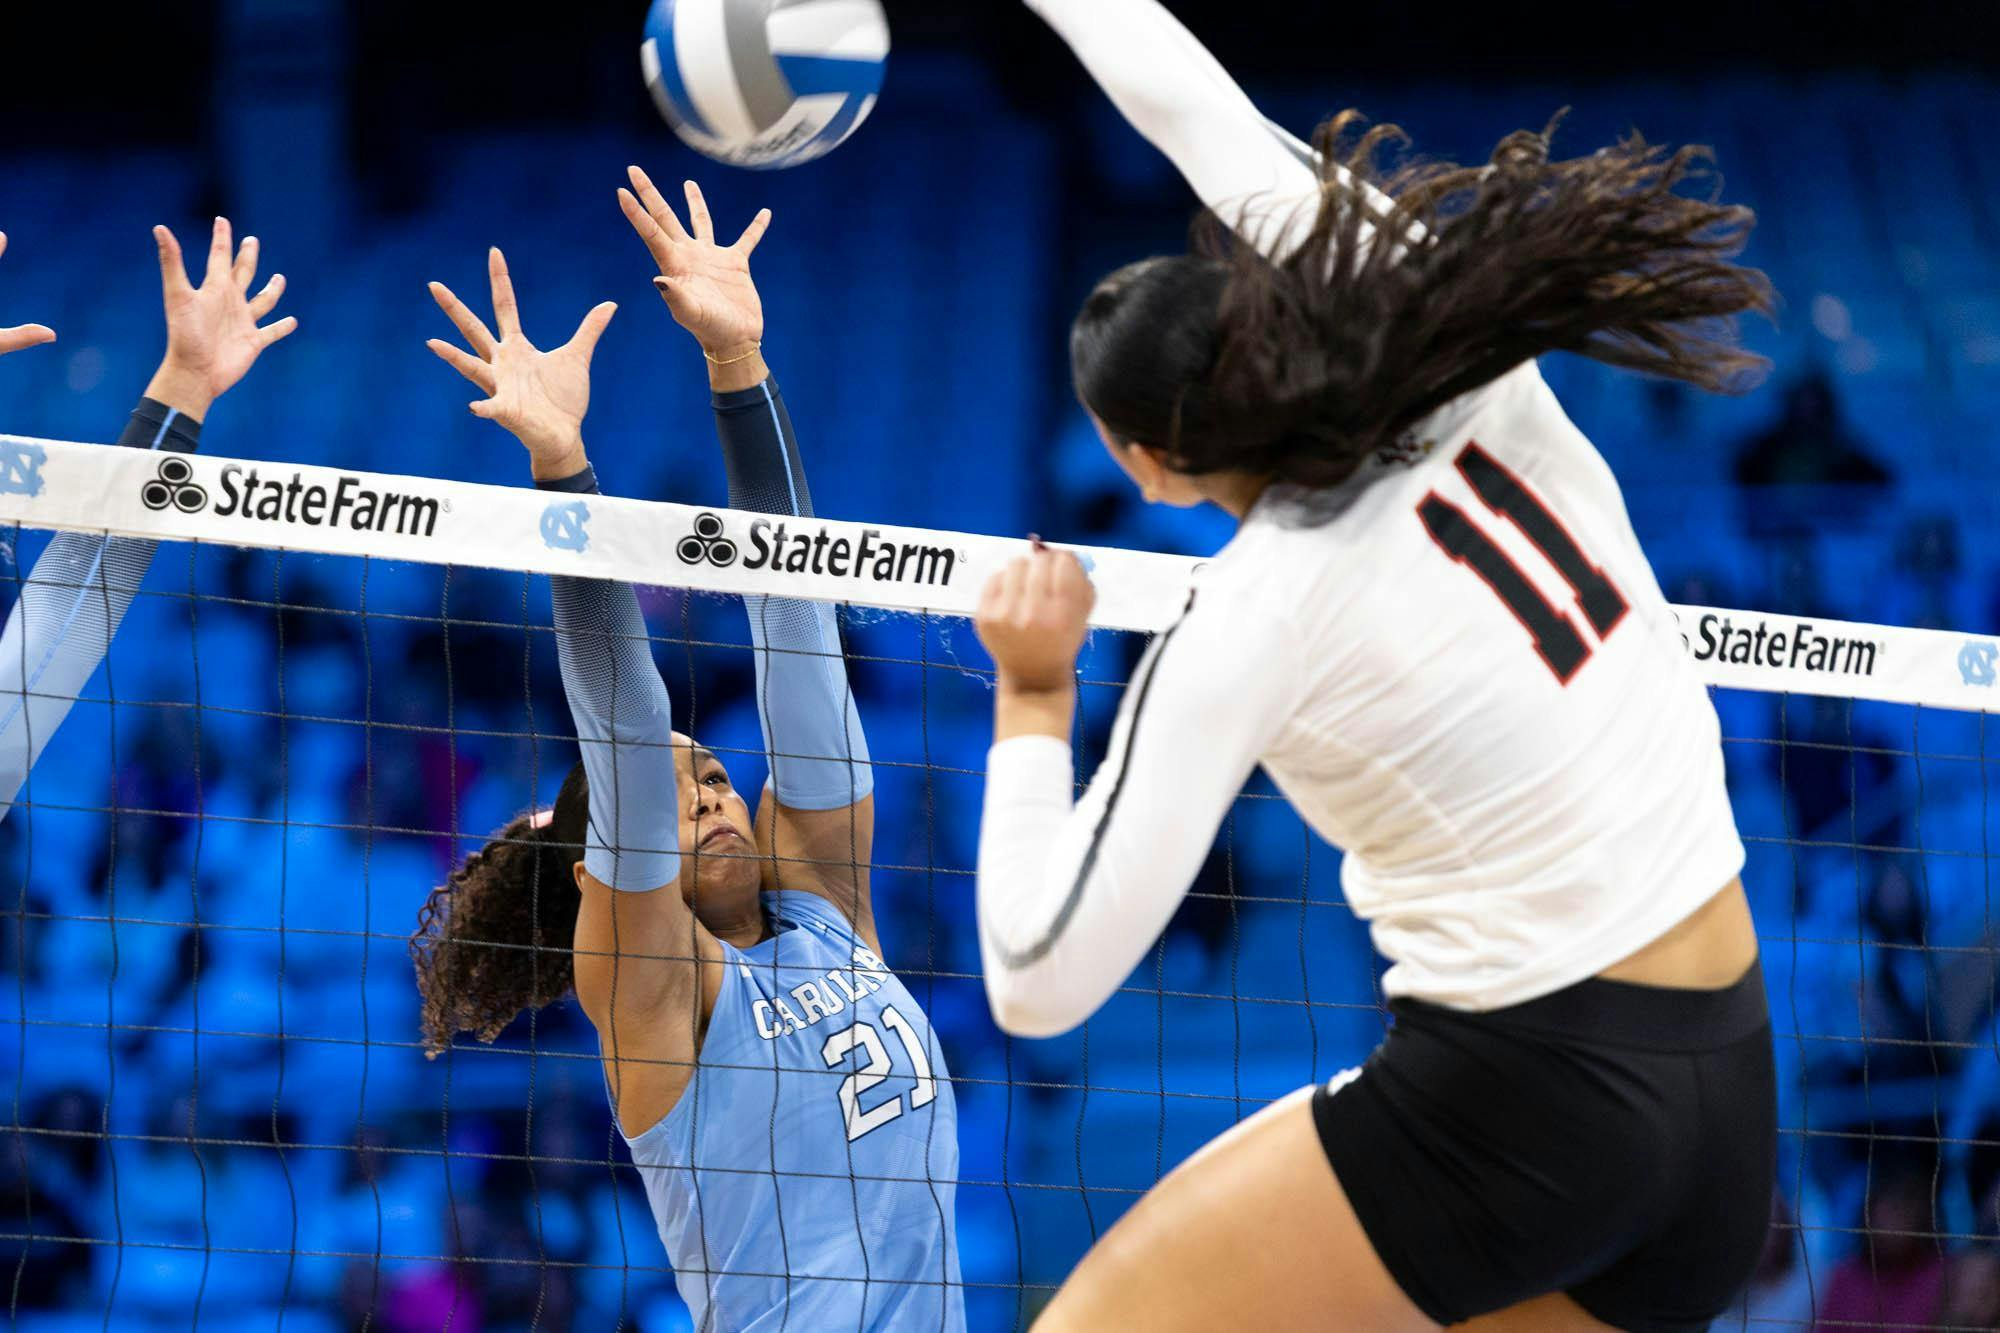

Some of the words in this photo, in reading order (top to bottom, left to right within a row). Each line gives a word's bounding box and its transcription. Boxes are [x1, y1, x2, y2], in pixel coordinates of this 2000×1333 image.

[1415, 440, 1631, 687] 11
[752, 945, 891, 1040] CAROLNA
[820, 1003, 937, 1143] 21
